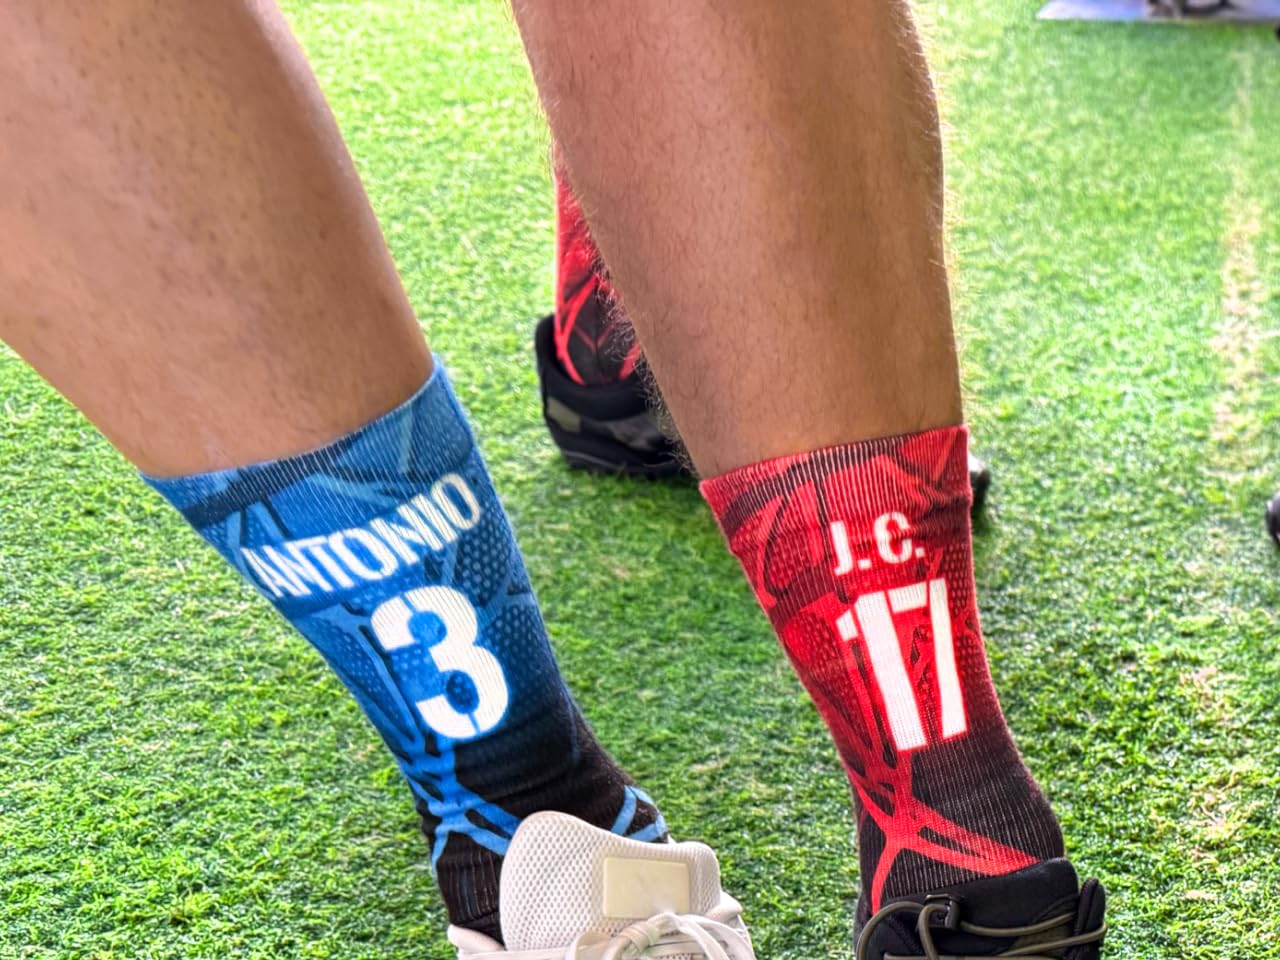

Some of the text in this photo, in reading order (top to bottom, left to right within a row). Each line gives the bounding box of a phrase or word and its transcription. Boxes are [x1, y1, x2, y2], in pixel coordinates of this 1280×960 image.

[239, 473, 480, 598] ANTONIO
[830, 511, 925, 576] J.C.
[371, 585, 508, 738] 3
[836, 577, 967, 751] 17
